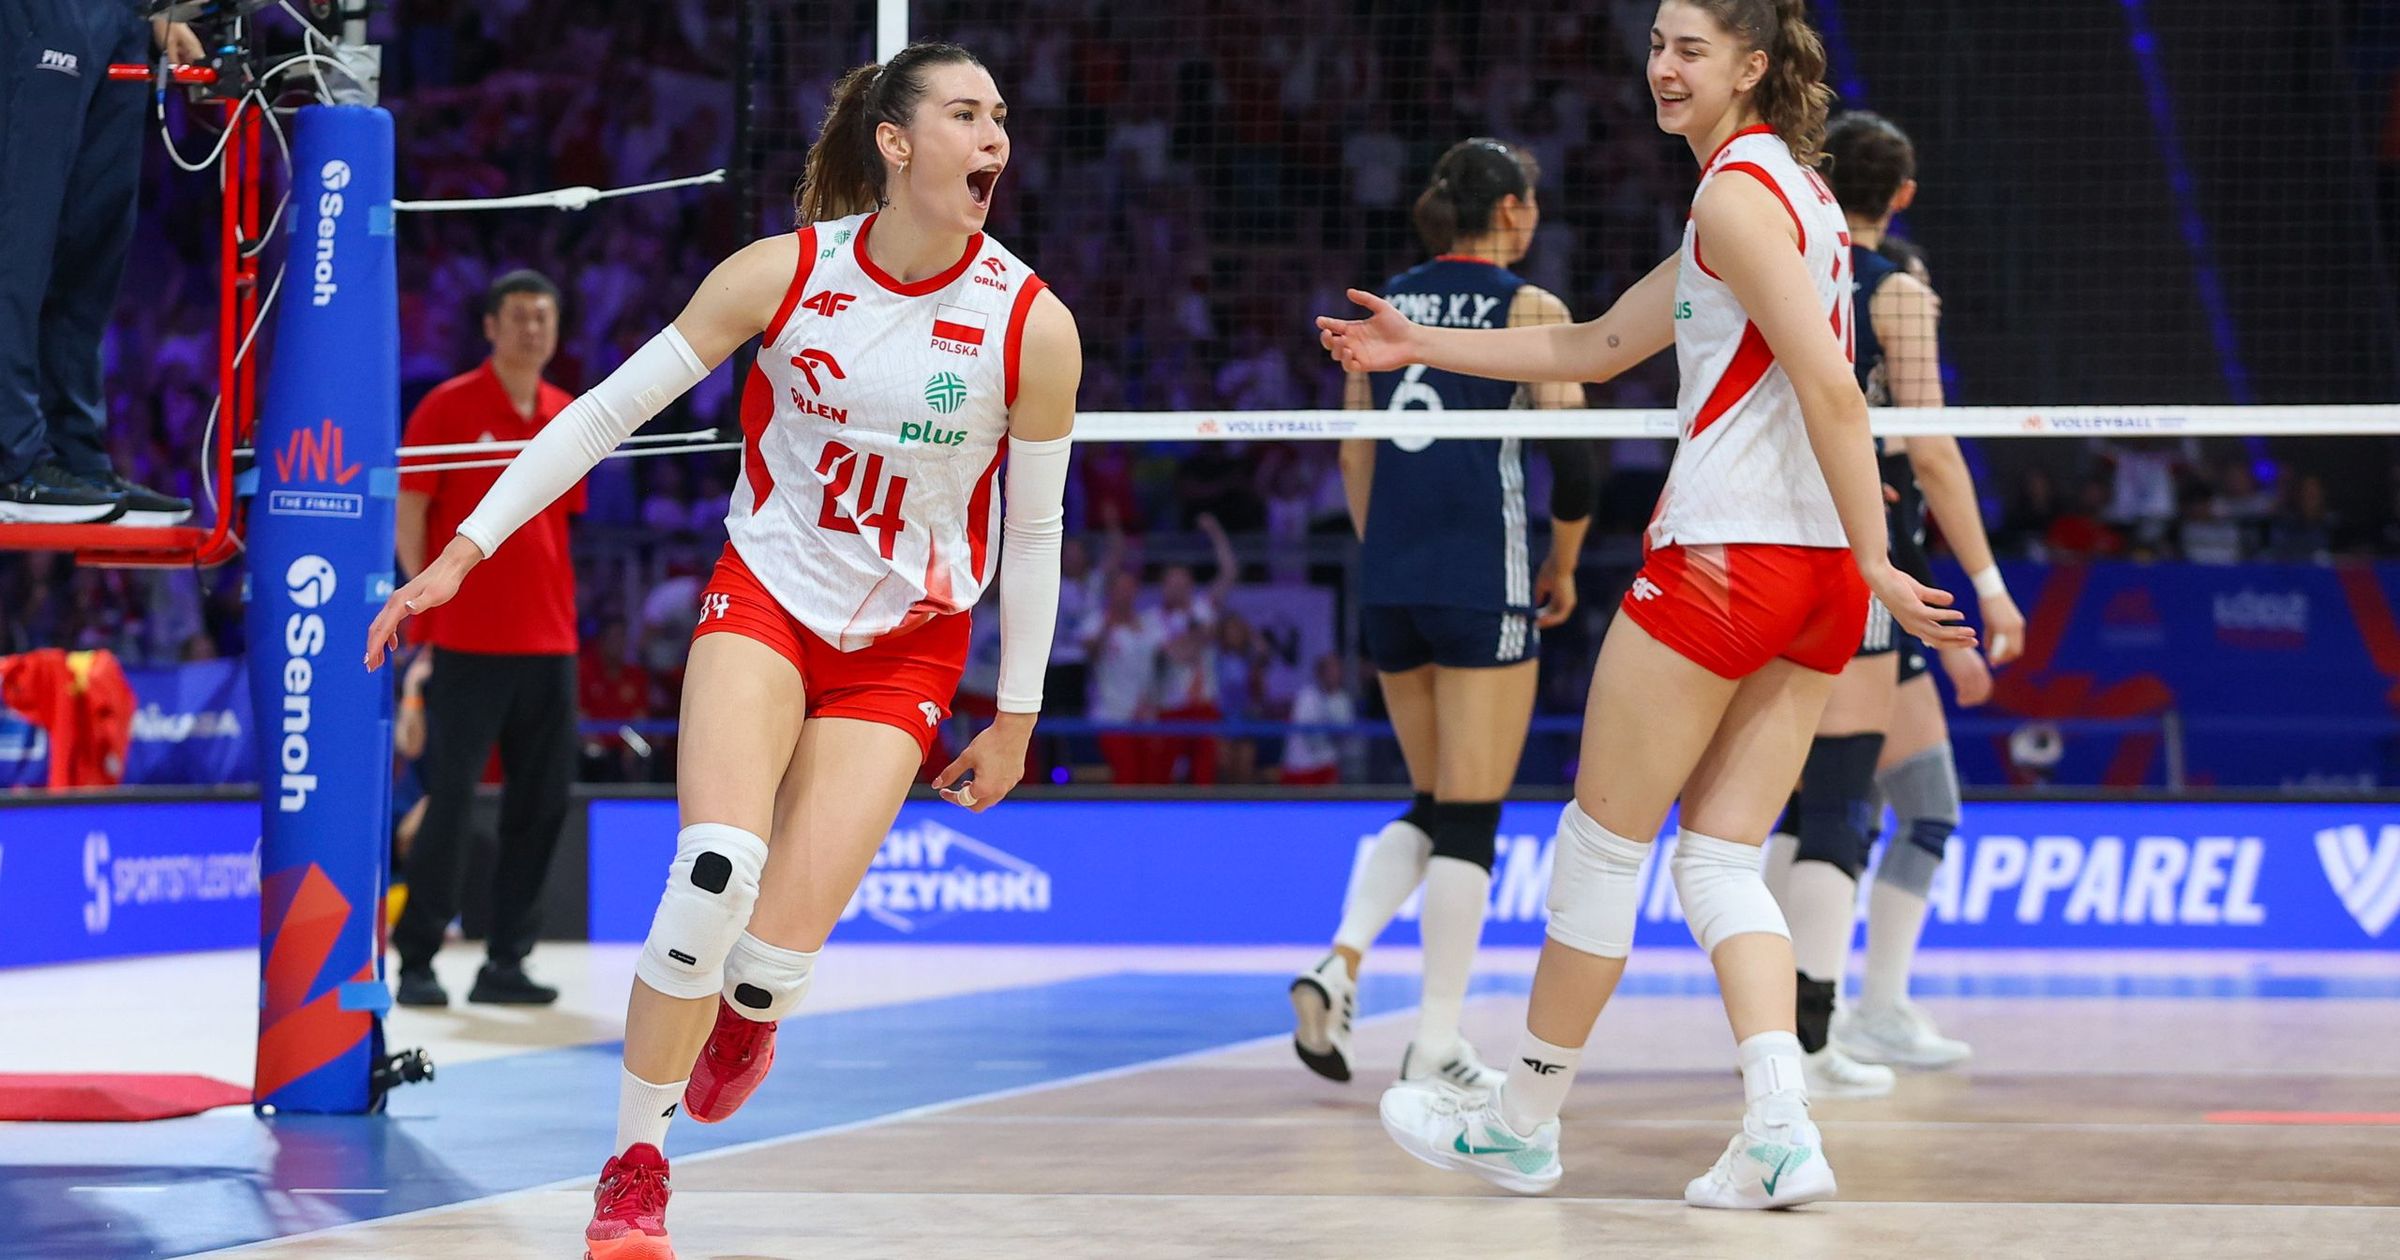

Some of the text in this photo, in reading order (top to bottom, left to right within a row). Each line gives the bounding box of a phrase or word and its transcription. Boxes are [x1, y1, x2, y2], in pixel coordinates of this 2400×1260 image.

[313, 192, 344, 307] Senoh
[802, 290, 857, 318] 4F
[930, 338, 978, 358] POLSKA
[790, 386, 848, 424] ORLEN
[899, 420, 968, 447] plus
[1387, 363, 1445, 453] 6
[274, 419, 362, 485] VNL
[279, 497, 352, 511] THE FINALS
[815, 440, 909, 560] 24
[280, 612, 326, 813] Senoh
[1926, 834, 2267, 925] APPAREL
